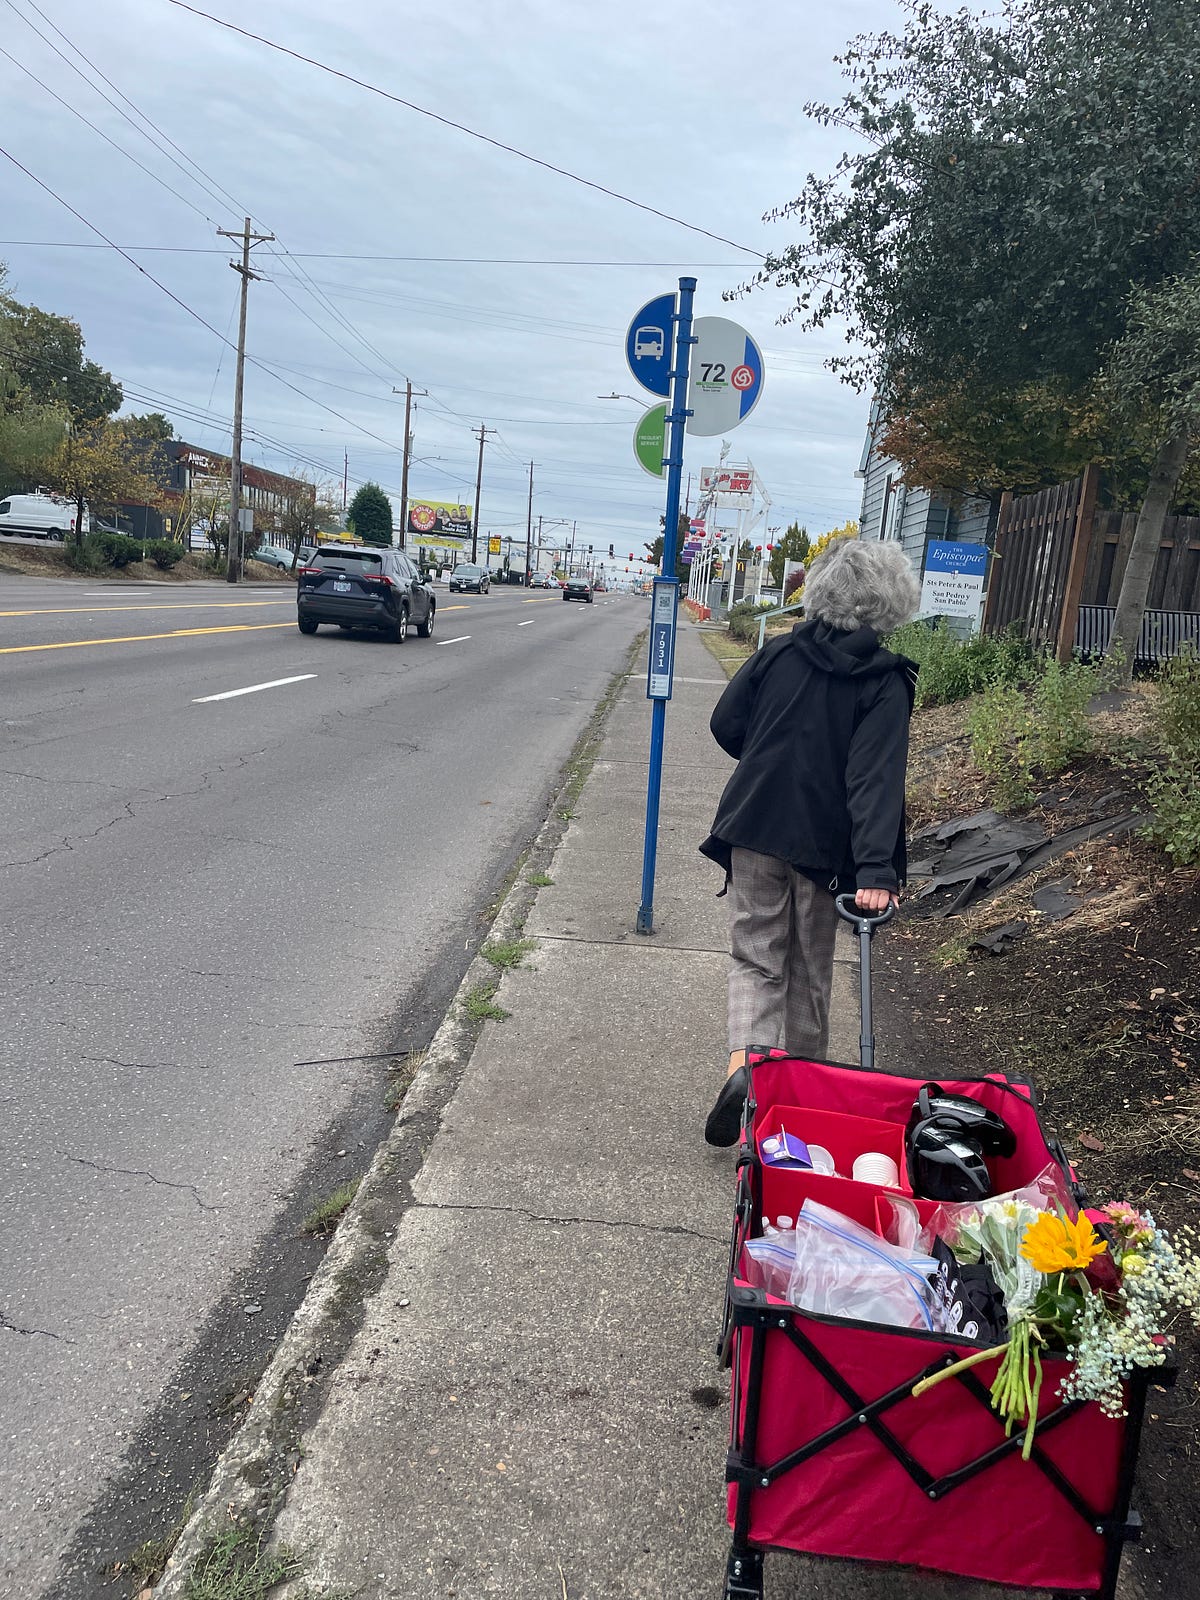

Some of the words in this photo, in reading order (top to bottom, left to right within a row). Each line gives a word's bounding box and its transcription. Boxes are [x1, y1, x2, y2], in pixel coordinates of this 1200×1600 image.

[701, 363, 726, 382] 72
[730, 479, 752, 490] RV
[938, 580, 955, 588] Peter
[945, 591, 965, 599] Pedro
[948, 598, 967, 606] Pablo
[658, 631, 666, 667] 7931
